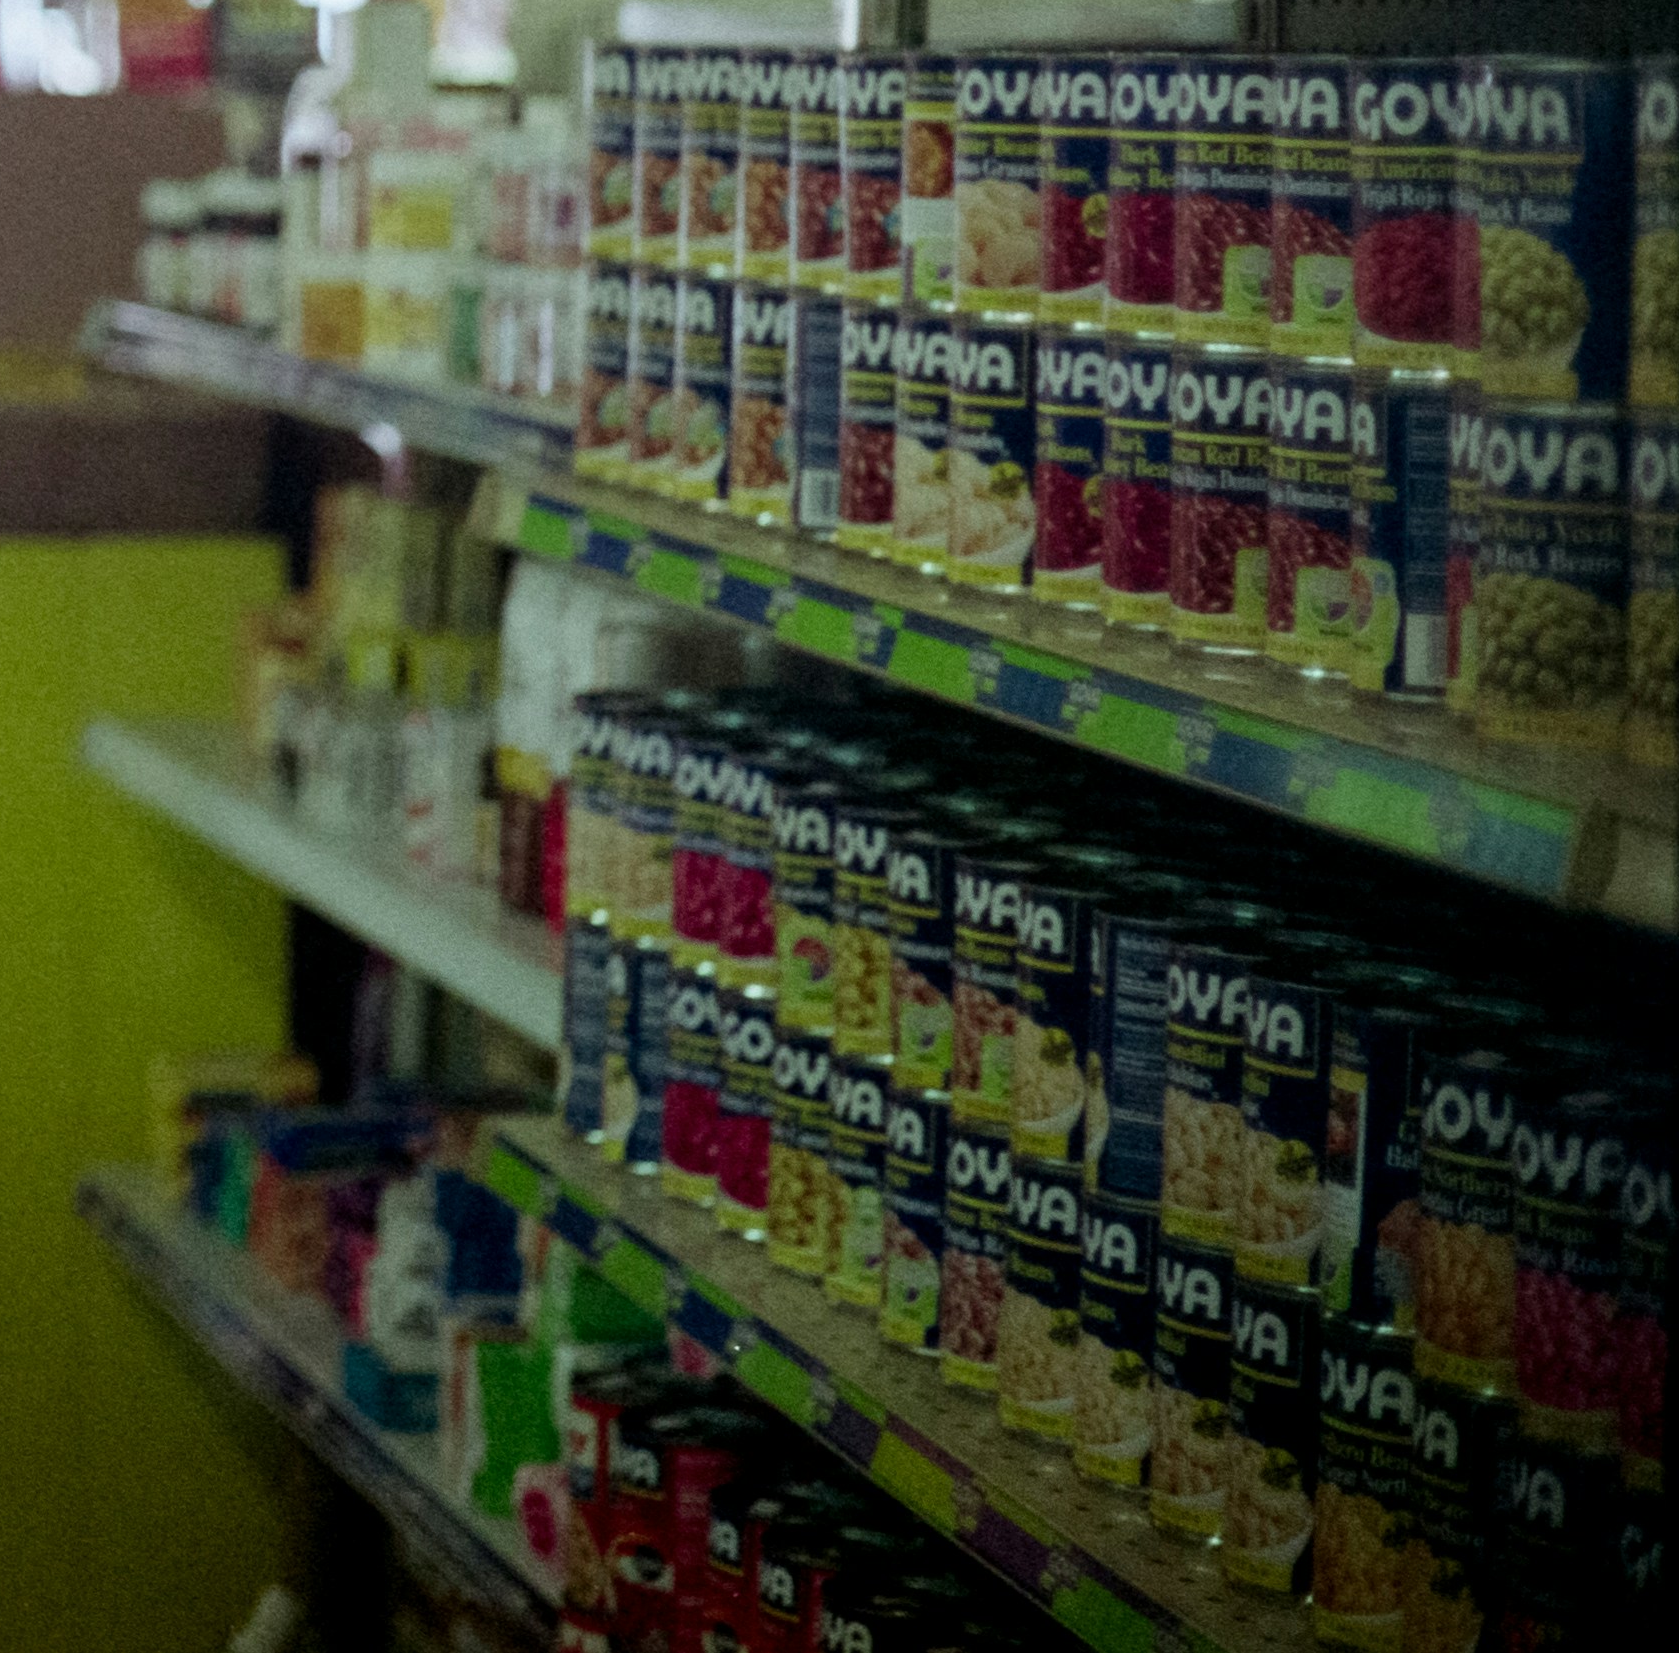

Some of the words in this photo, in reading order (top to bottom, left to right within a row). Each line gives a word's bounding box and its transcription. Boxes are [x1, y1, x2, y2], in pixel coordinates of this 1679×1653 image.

[1041, 70, 1109, 121] YA
[1277, 76, 1341, 130] YA
[1493, 84, 1572, 143] YA
[953, 341, 1017, 391] YA
[1038, 349, 1109, 400] YA
[1275, 384, 1347, 443] YA
[1011, 1177, 1081, 1239] YA
[1157, 1252, 1226, 1322] YA
